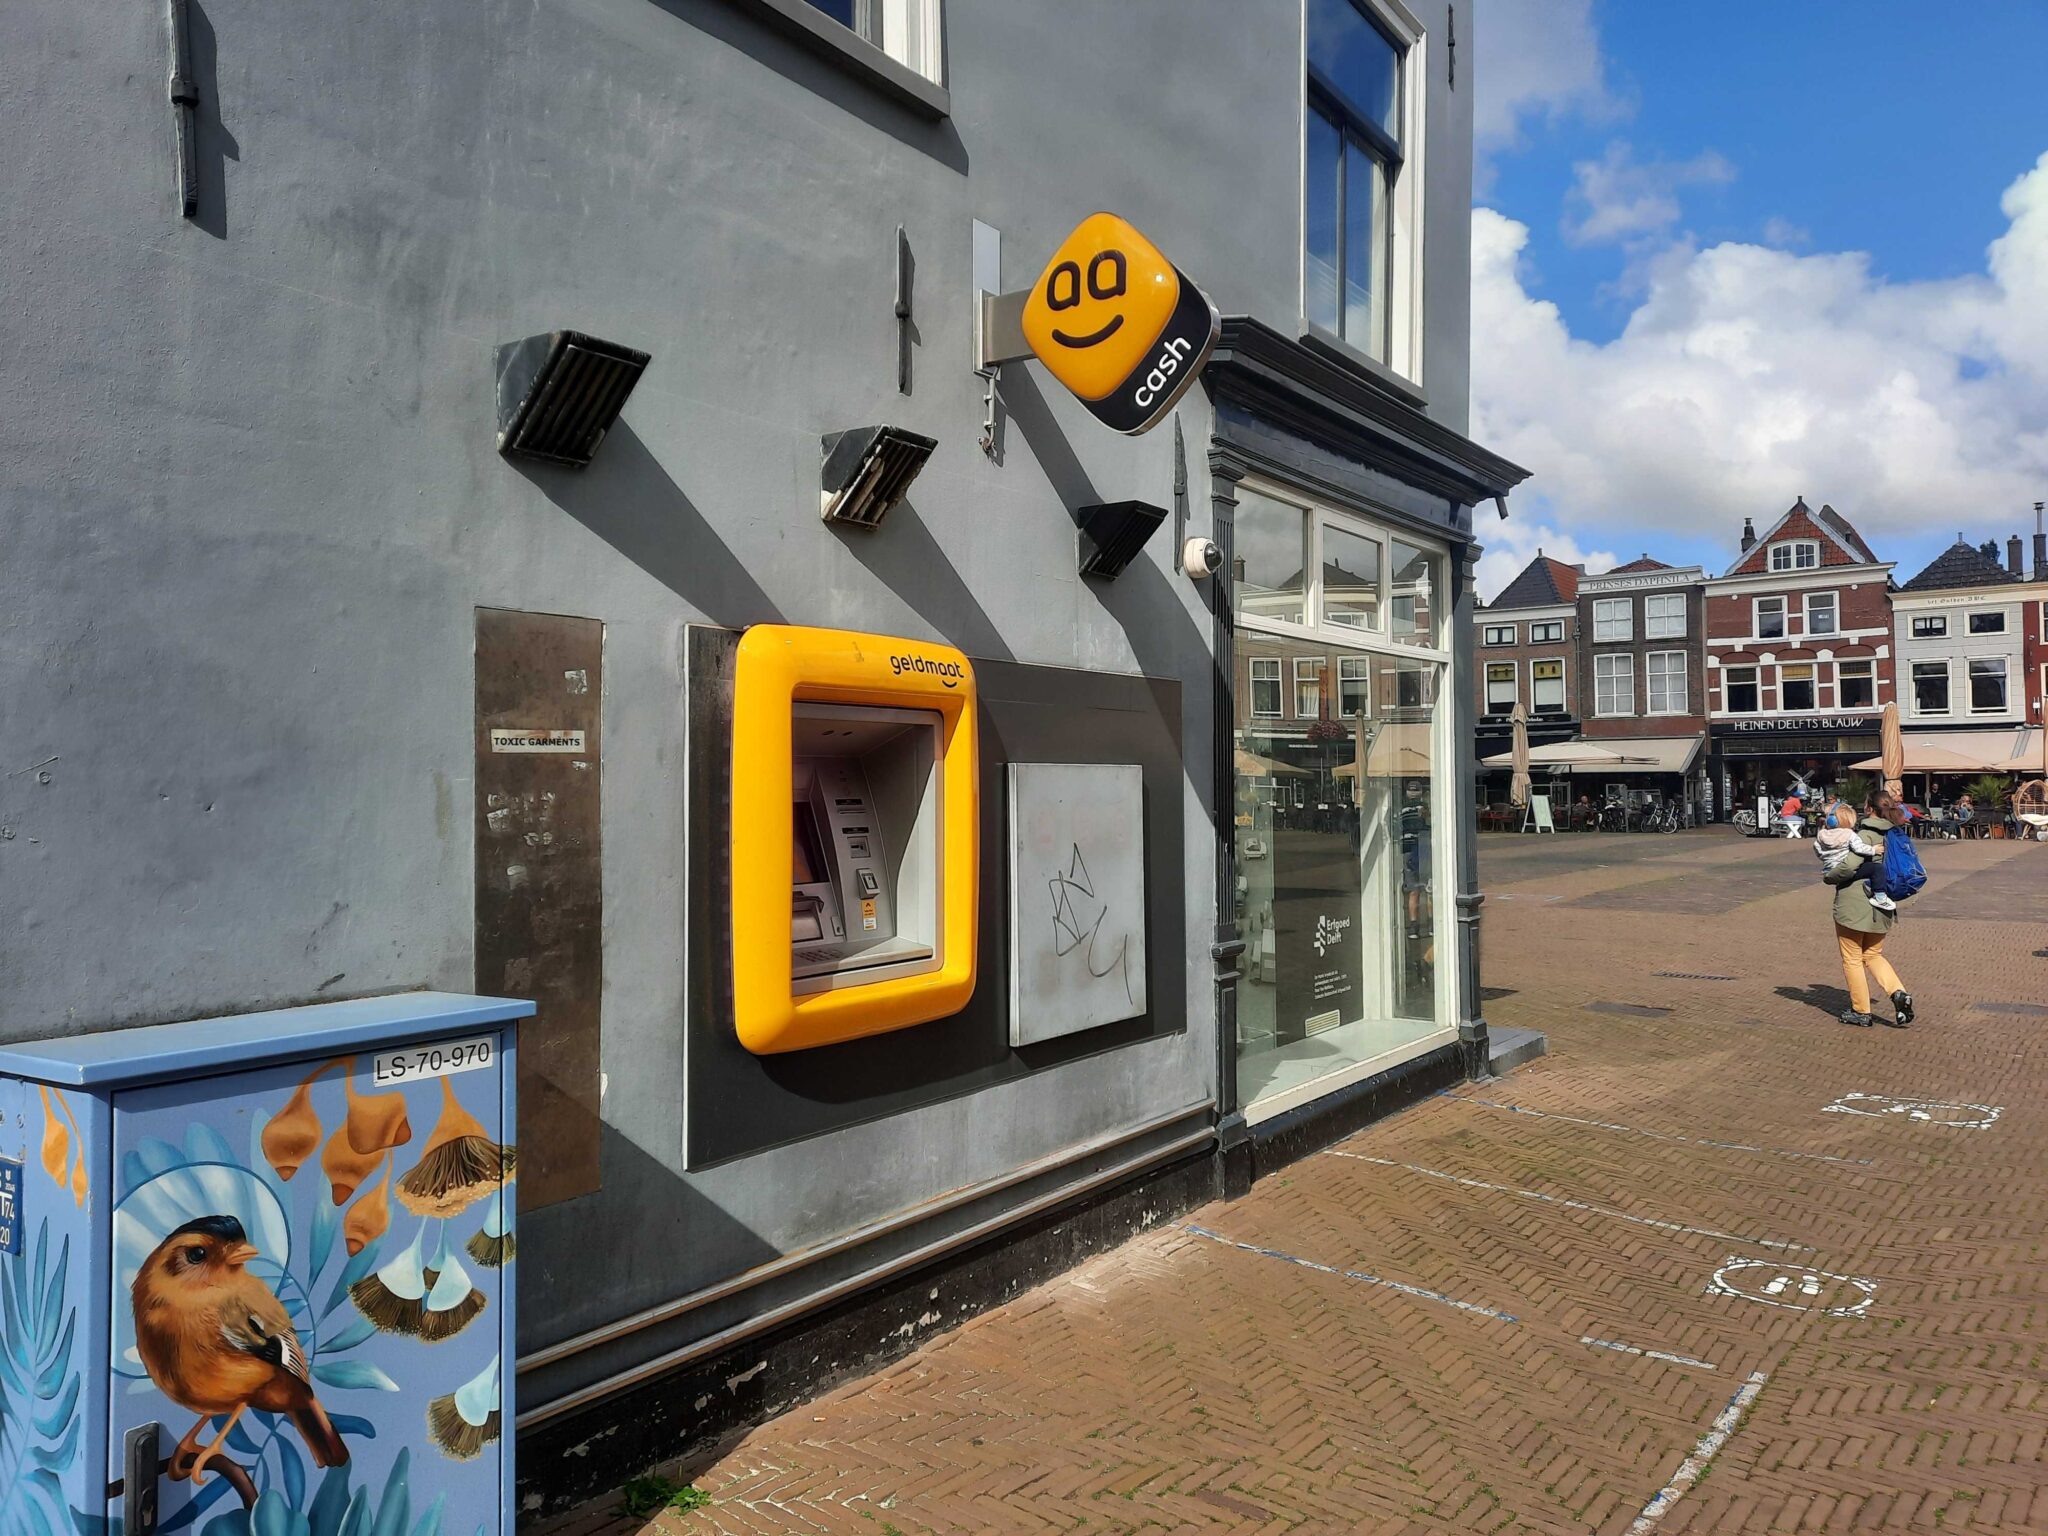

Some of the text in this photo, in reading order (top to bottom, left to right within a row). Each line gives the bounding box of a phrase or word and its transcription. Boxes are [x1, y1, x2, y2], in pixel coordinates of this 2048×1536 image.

[1134, 336, 1192, 407] cash
[1590, 579, 1632, 590] PRINSES
[890, 653, 965, 678] geldmaat
[1734, 720, 1775, 731] HEINEN
[1777, 718, 1819, 730] DELFTS
[493, 736, 581, 746] TOXIC GARMENTS
[1326, 916, 1350, 932] Erfgoed
[1326, 931, 1342, 945] Delft
[377, 1042, 490, 1080] LS-70-970
